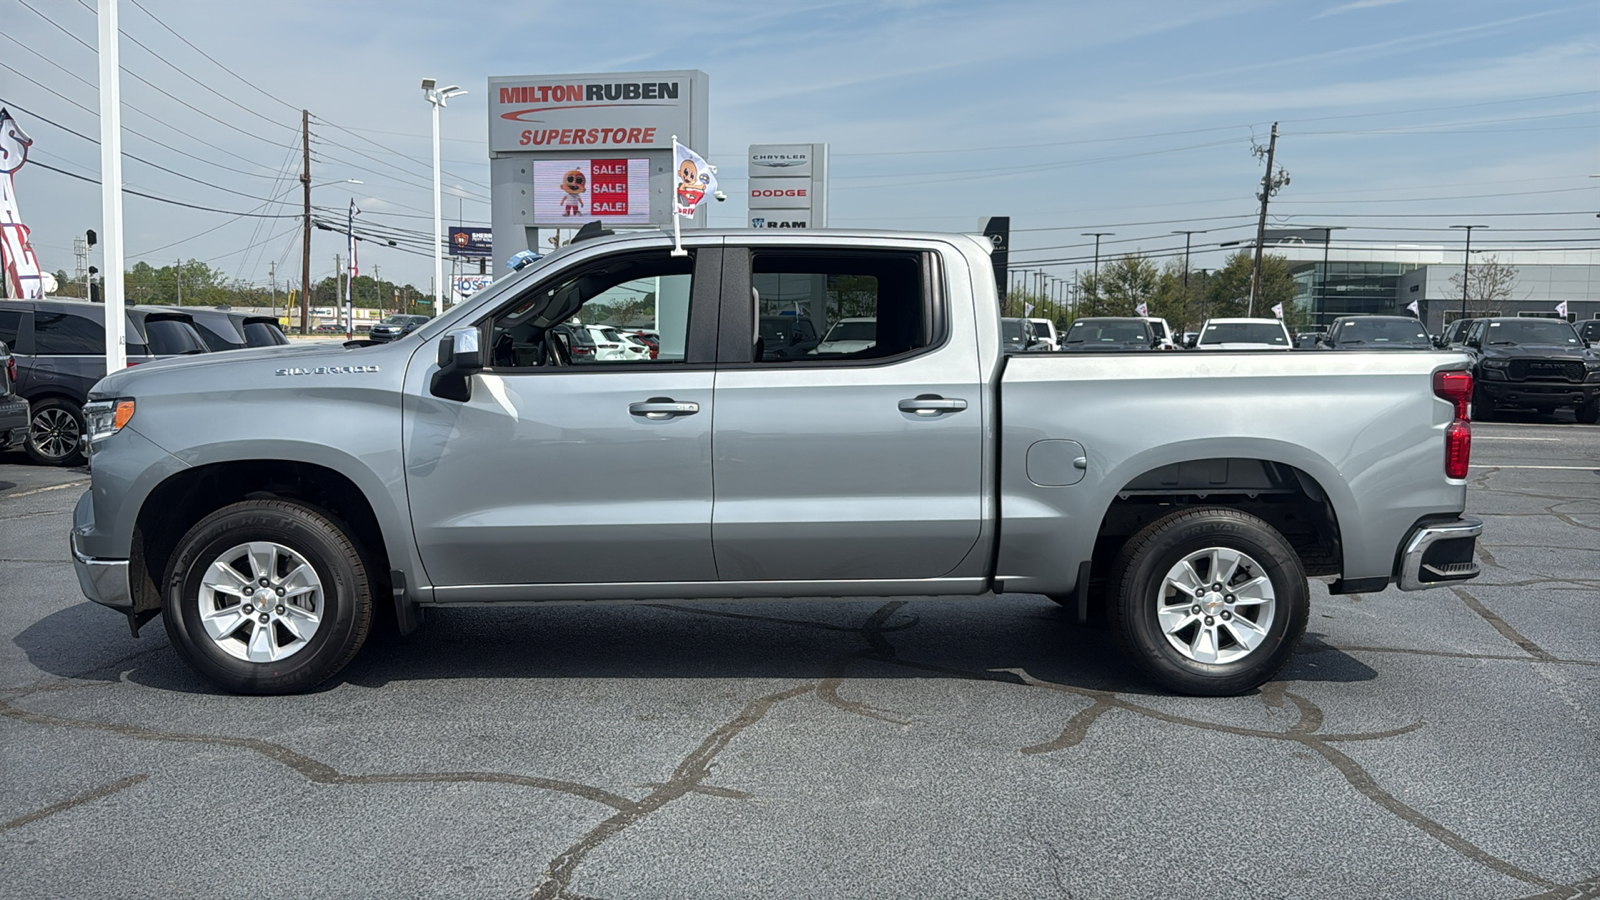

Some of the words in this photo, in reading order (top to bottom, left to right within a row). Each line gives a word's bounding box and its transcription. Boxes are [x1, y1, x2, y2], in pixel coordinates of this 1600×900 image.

[499, 84, 583, 104] MILTON
[585, 82, 678, 101] RUBEN
[519, 127, 656, 146] SUPERSTORE
[592, 164, 626, 175] SALE!
[592, 183, 626, 194] SALE!
[751, 189, 807, 197] DODGE
[592, 202, 626, 212] SALE!
[275, 365, 380, 377] SILVERADO
